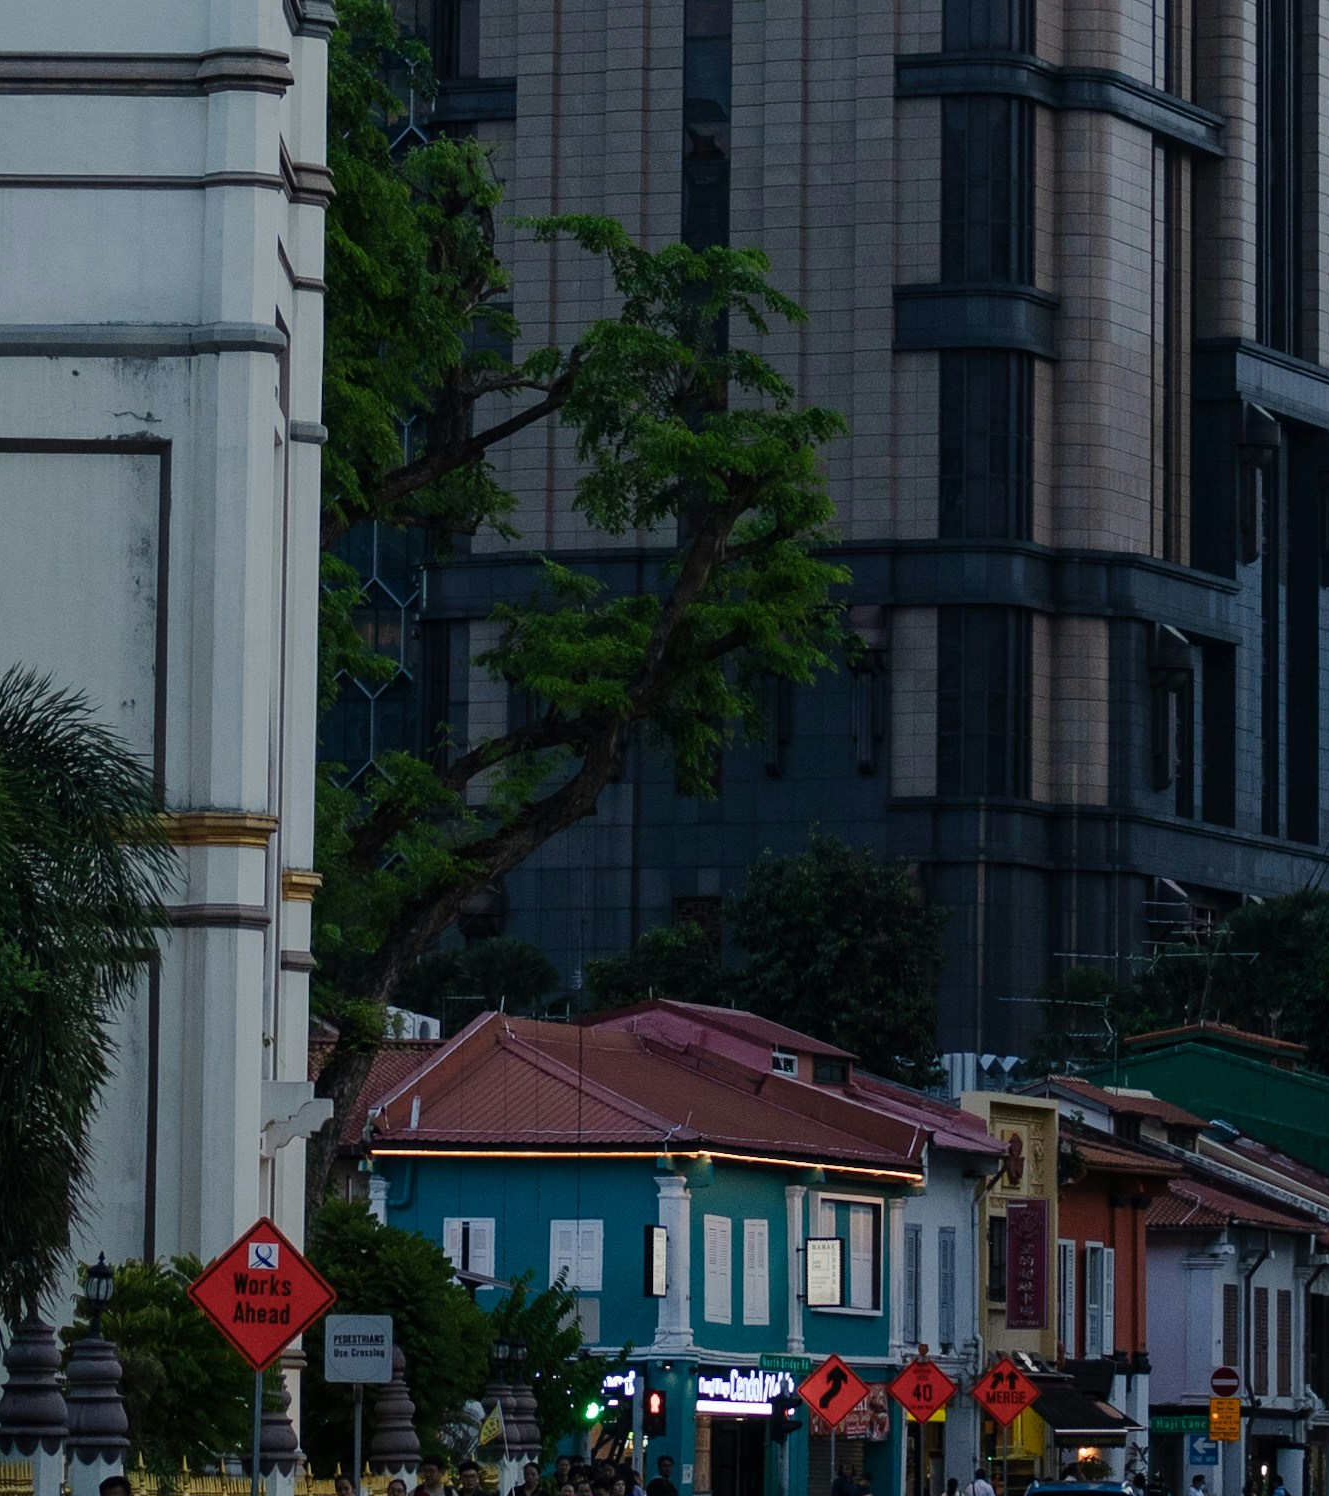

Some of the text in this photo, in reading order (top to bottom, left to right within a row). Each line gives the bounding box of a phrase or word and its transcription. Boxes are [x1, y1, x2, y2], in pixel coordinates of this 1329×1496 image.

[233, 1273, 292, 1297] Works
[233, 1302, 291, 1325] Ahead
[334, 1335, 384, 1346] PEDESTRIANS
[334, 1349, 385, 1360] Use Crossing
[763, 1355, 810, 1370] North Bridge Rd
[730, 1368, 763, 1402] Cendol
[913, 1384, 933, 1402] 40
[986, 1391, 1026, 1405] MERGE
[1157, 1417, 1207, 1431] Haji Lane
